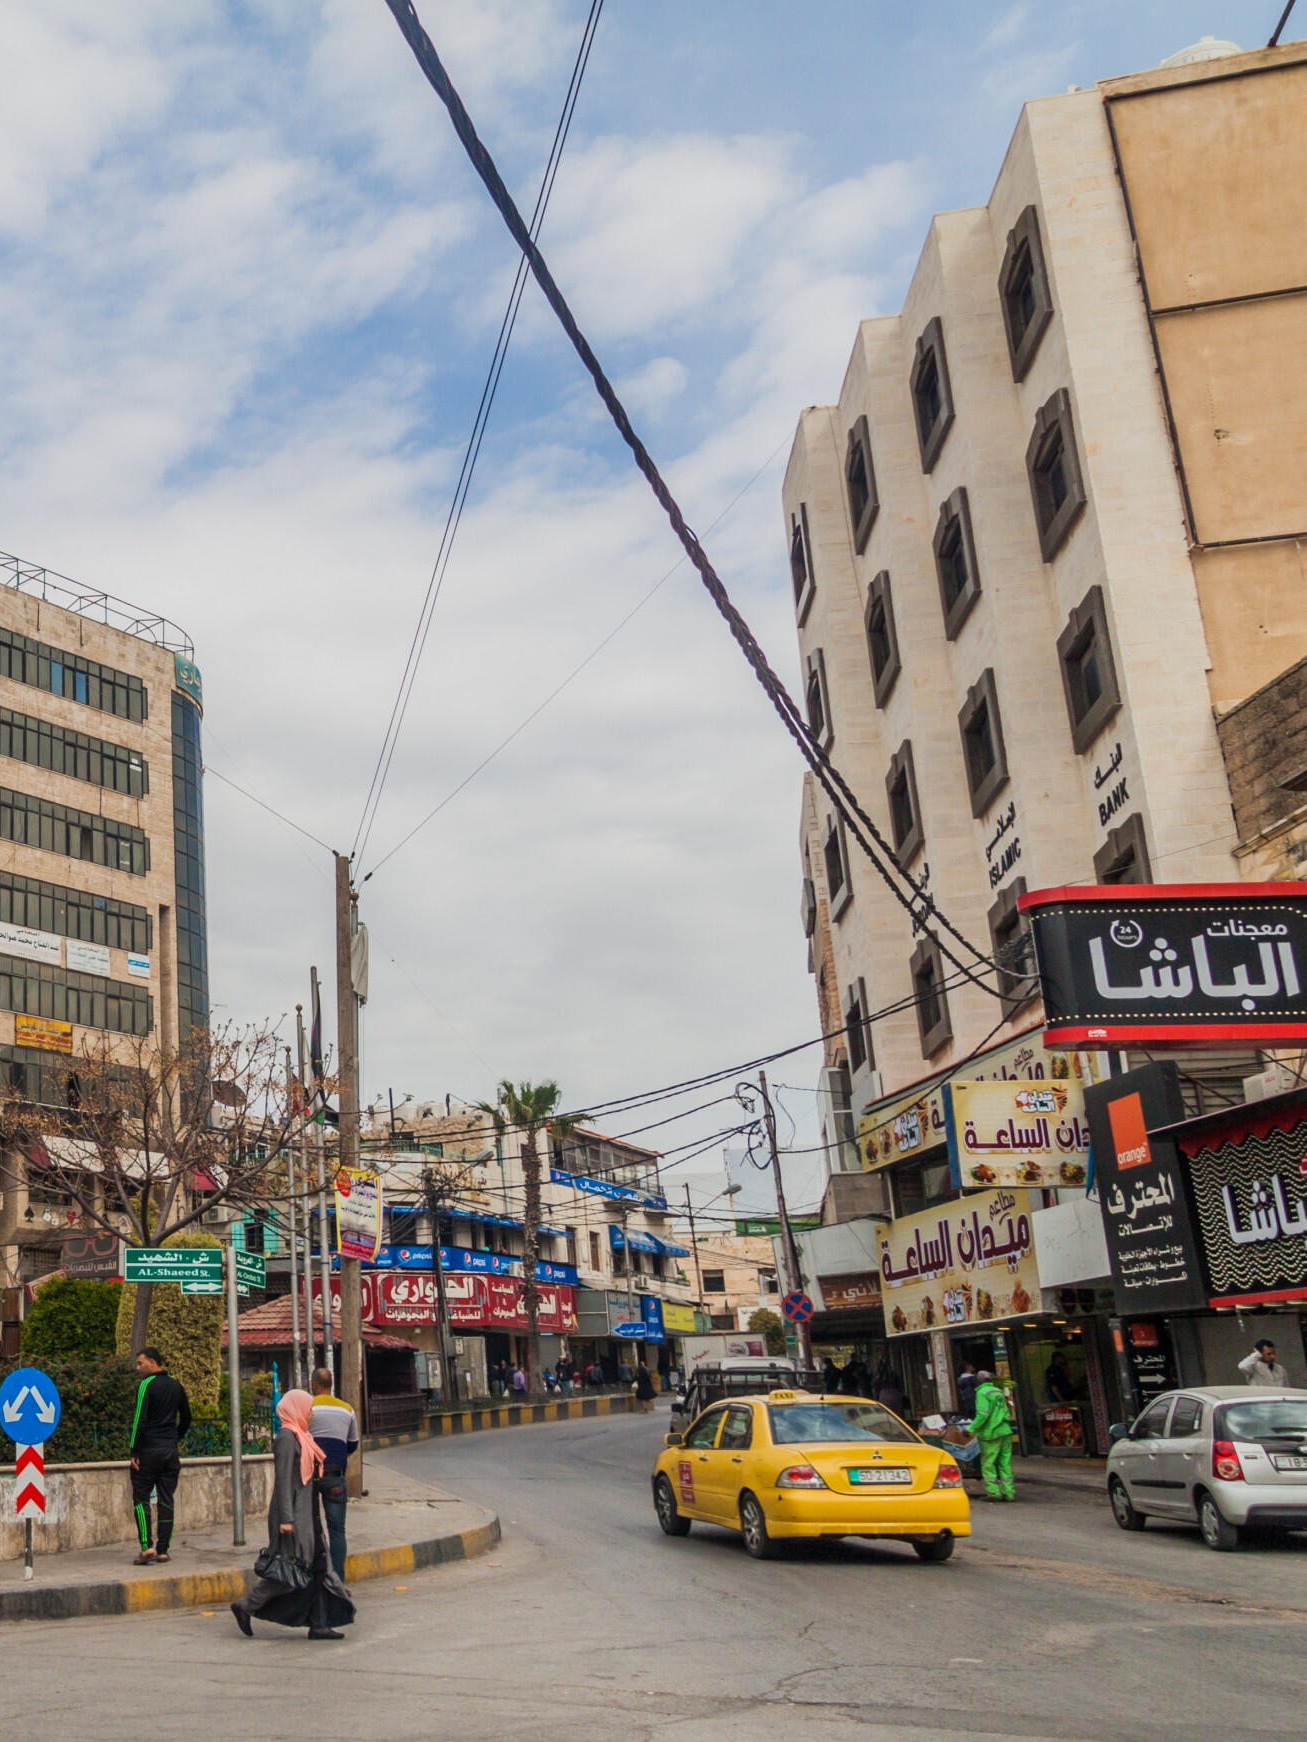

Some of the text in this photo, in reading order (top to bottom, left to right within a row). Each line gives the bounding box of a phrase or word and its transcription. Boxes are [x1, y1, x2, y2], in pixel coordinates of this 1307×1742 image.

[1099, 777, 1130, 827] BANK
[988, 837, 1022, 890] ISLAMIC
[1119, 926, 1132, 934] 24
[1206, 919, 1288, 941] معجنات
[1088, 934, 1301, 1011] الباشا
[964, 1116, 1091, 1151] دان الساعة
[1117, 1147, 1147, 1165] orange
[1107, 1171, 1176, 1220] المحترف
[1221, 1172, 1307, 1245] باشا
[411, 1252, 433, 1261] pepsi
[881, 1211, 1031, 1282] ميدان الساعة
[138, 1252, 183, 1264] الشهيد
[471, 1258, 487, 1268] pepsi
[553, 1269, 566, 1279] pepsi
[390, 1277, 474, 1303] الحواري
[445, 1309, 481, 1321] للصياغ
[773, 1391, 794, 1400] TAXI
